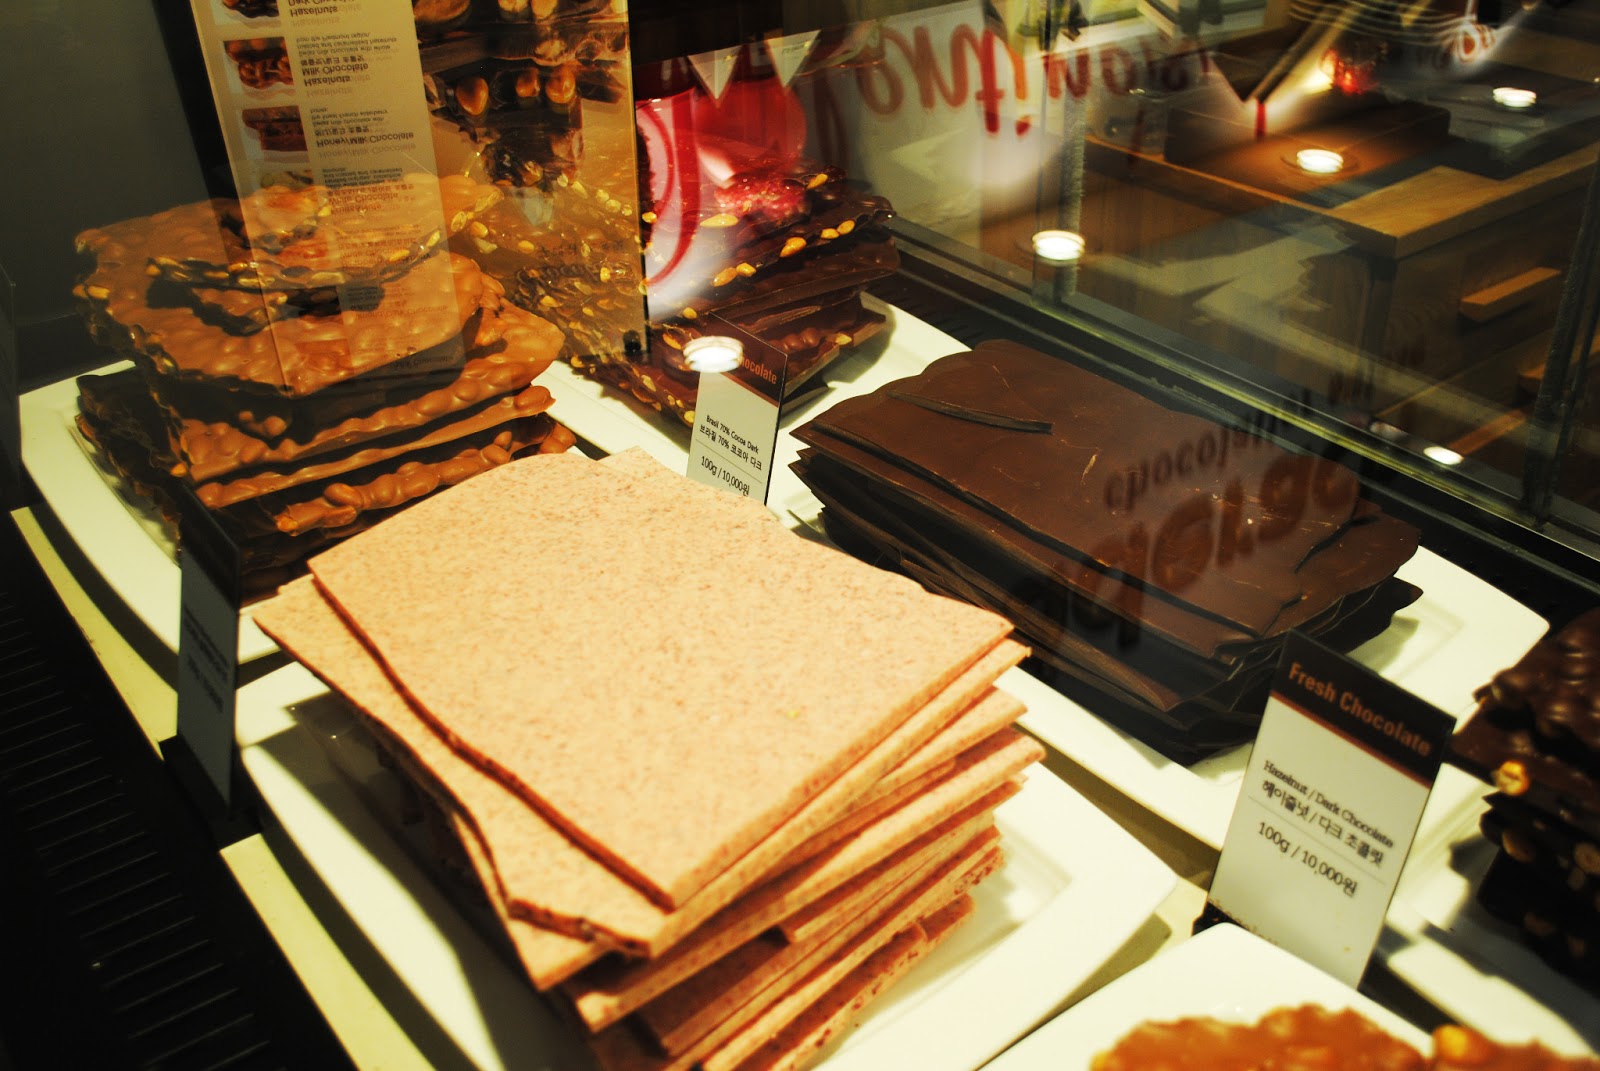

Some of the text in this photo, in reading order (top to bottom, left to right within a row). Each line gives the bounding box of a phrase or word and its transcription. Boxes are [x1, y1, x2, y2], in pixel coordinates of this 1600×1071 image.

[699, 424, 762, 471] 브라질 70% 코코아 다크
[706, 414, 759, 454] Brasil 70% Cocoa Dark
[701, 455, 718, 476] 100g
[1289, 661, 1431, 757] Fresh Chocolate
[1263, 760, 1308, 795] Hazelnut
[1315, 792, 1340, 815] Dark
[1341, 809, 1394, 848] Chocolate
[1258, 821, 1291, 853] 100g
[1318, 815, 1343, 840] 다크
